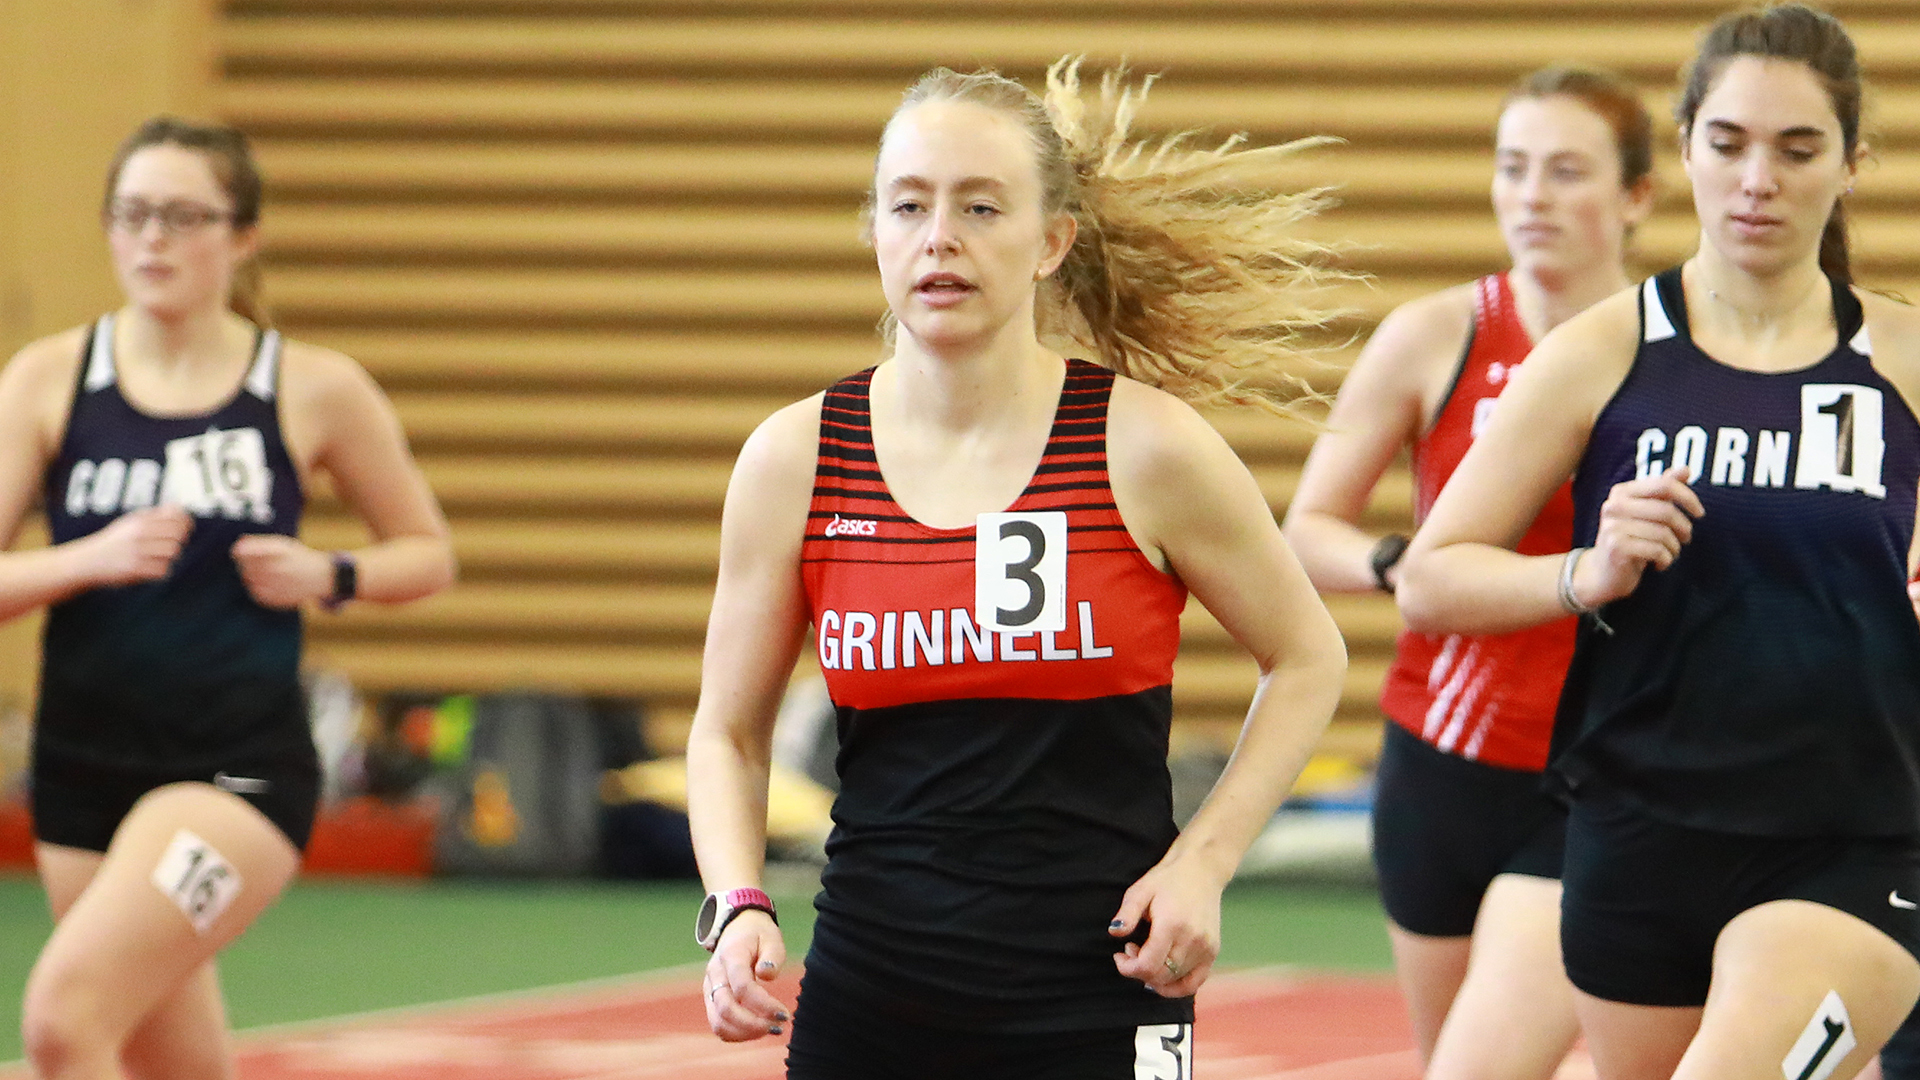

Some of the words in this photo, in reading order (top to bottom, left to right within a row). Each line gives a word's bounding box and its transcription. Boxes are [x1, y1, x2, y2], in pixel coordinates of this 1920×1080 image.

[191, 431, 251, 496] 16
[1633, 425, 1887, 500] CORN
[1818, 392, 1854, 477] 1
[836, 518, 878, 536] asics
[995, 520, 1046, 627] 3
[175, 847, 230, 918] 16
[1795, 1015, 1845, 1080] 1
